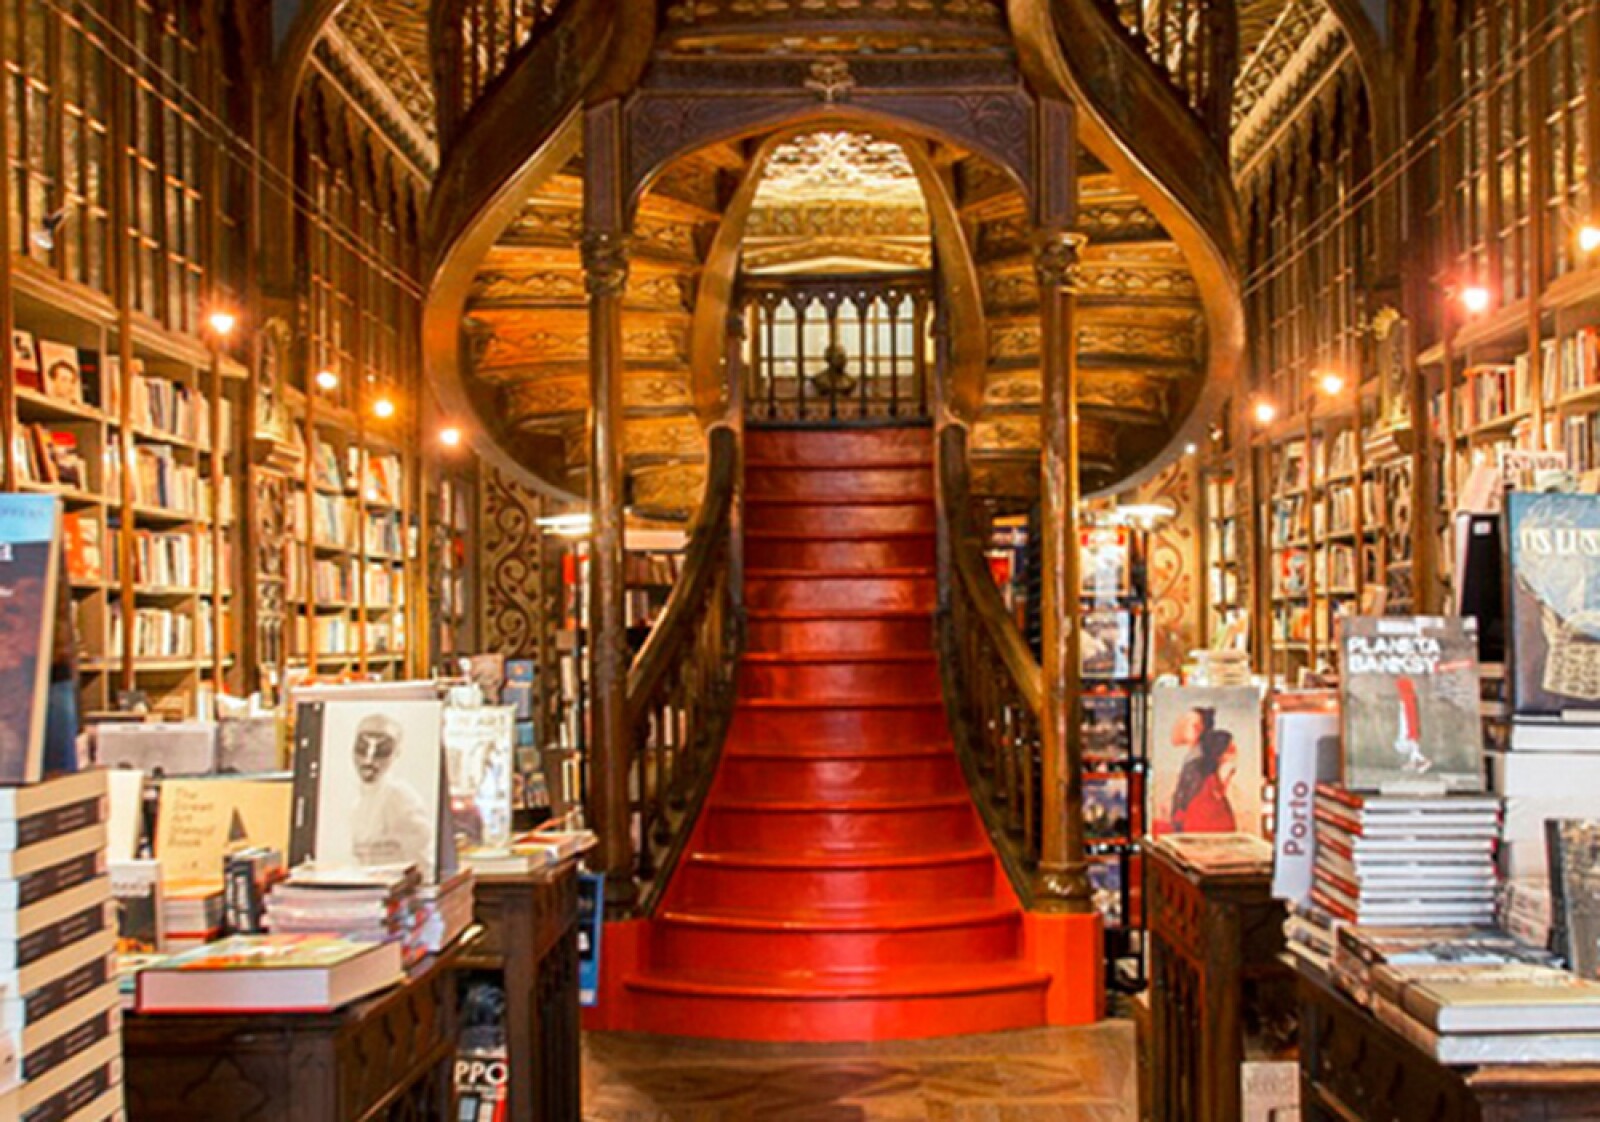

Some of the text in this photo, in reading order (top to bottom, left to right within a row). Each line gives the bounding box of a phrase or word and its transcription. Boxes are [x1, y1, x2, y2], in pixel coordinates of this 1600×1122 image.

[1346, 636, 1440, 655] PLANETA
[1347, 653, 1440, 674] BANKSY
[1282, 780, 1309, 856] Porto
[453, 1060, 509, 1086] PPO
